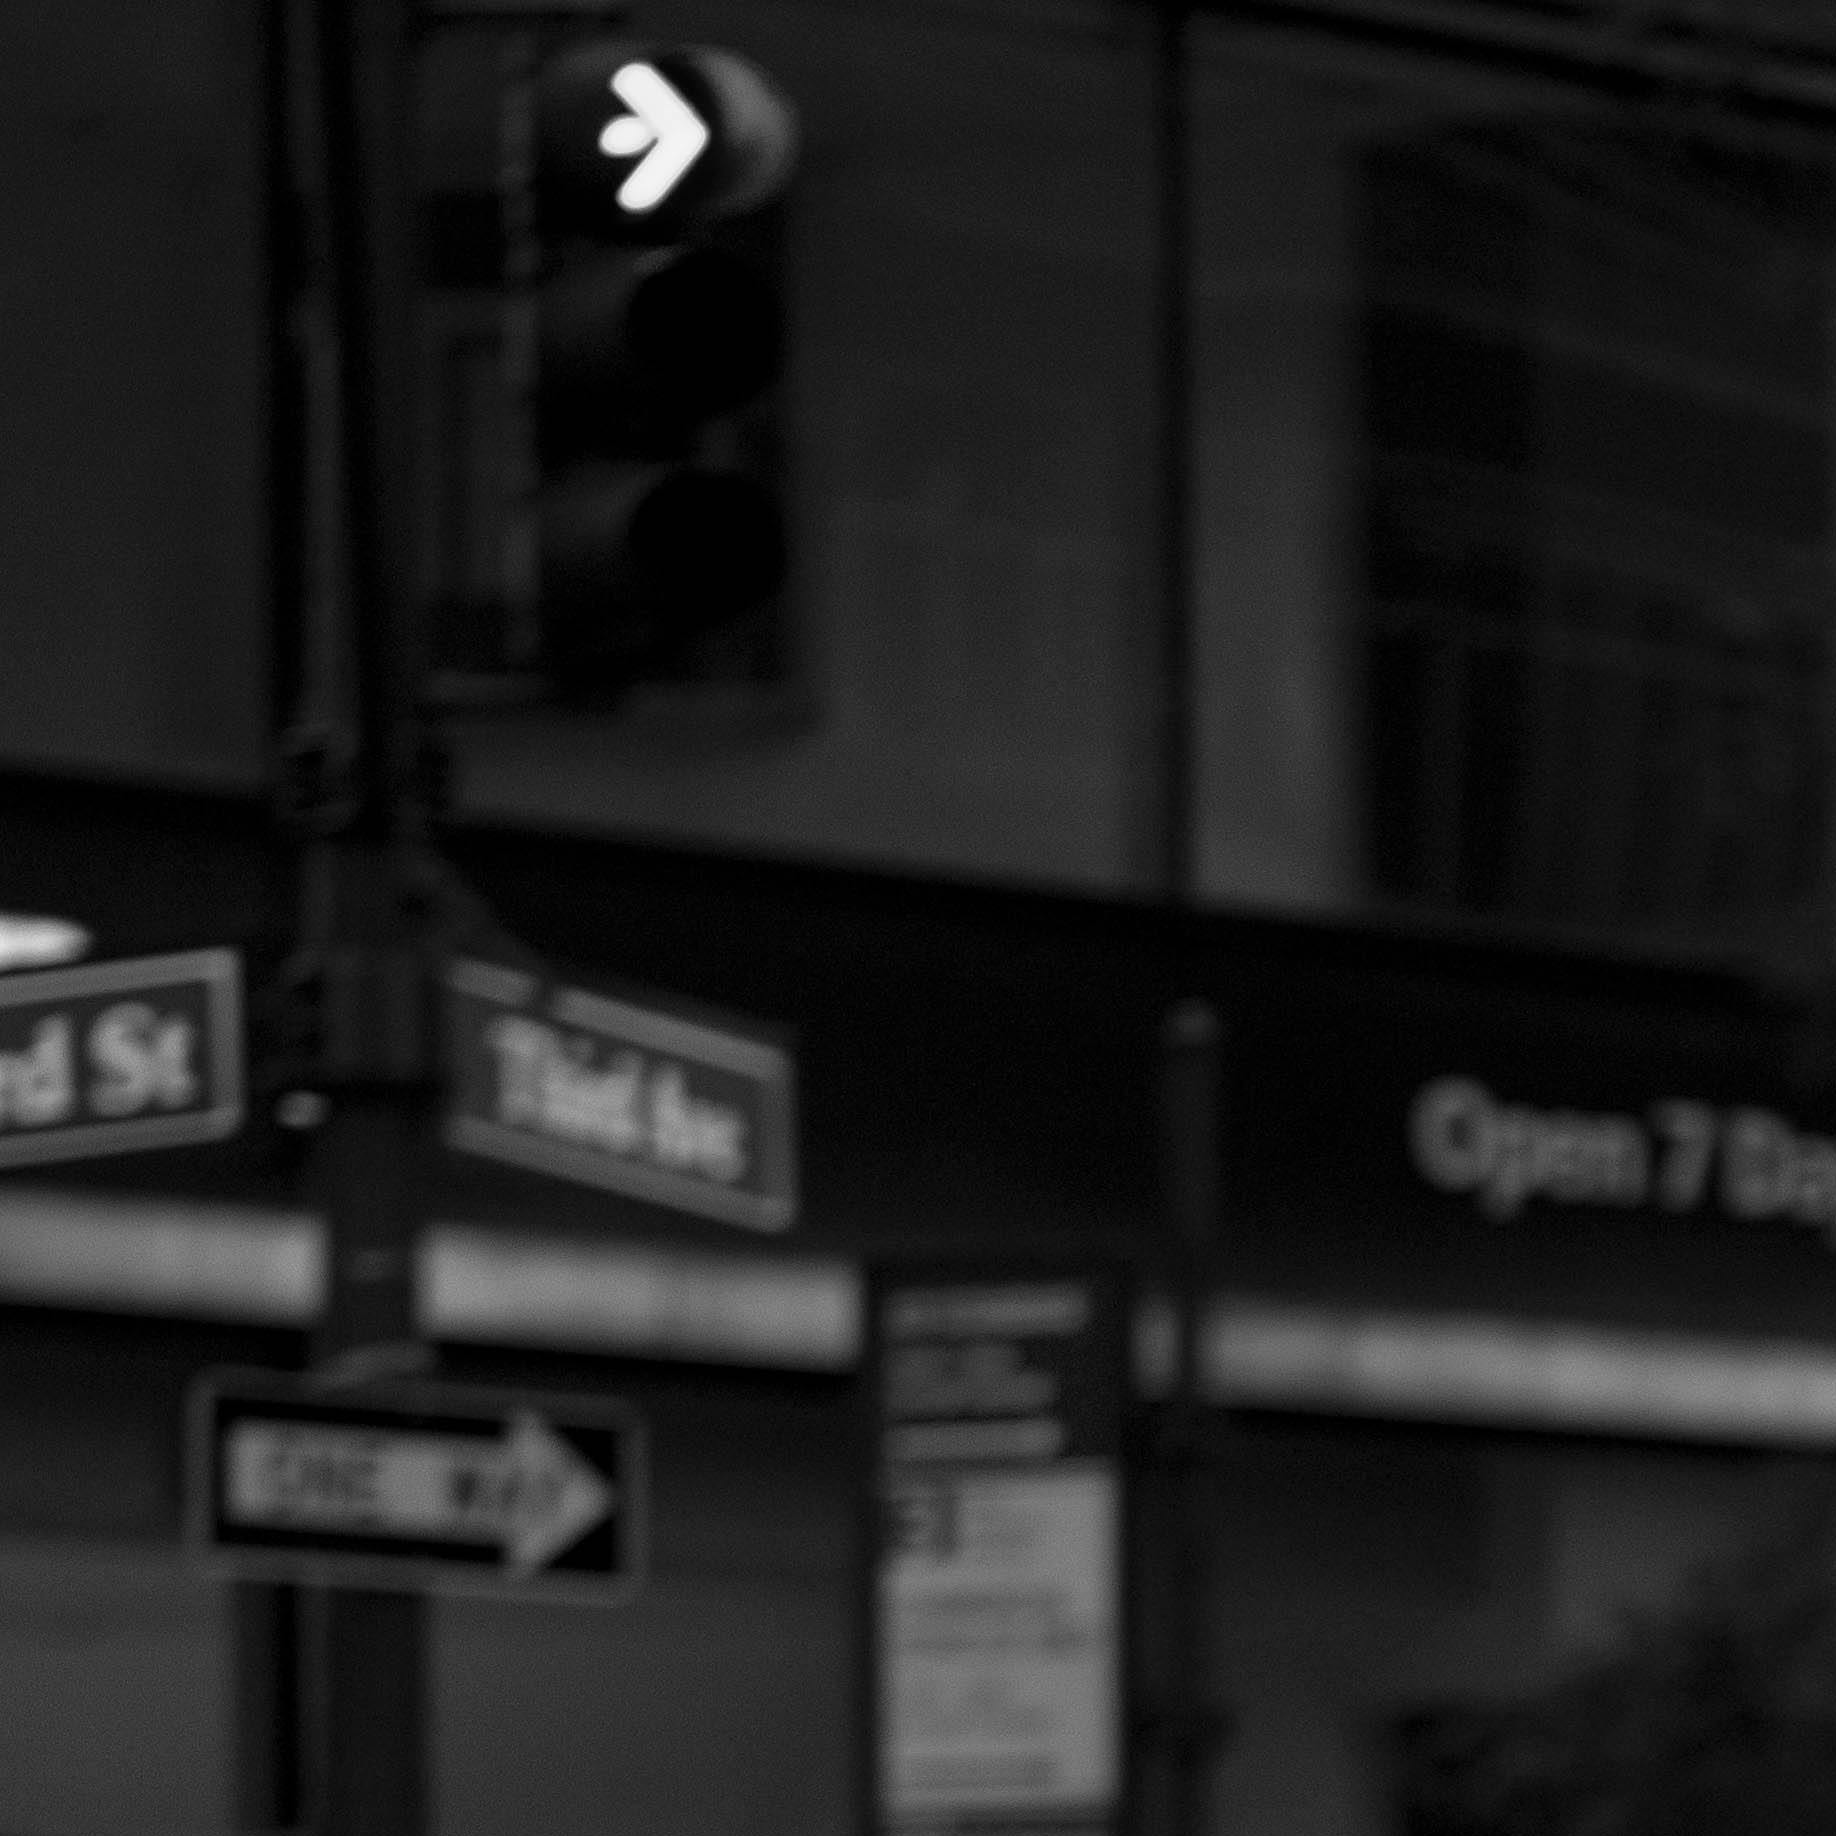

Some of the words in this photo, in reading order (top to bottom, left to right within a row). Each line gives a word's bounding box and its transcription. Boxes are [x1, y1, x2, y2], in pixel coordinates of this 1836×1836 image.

[88, 1000, 196, 1117] St
[1411, 1076, 1646, 1220] Open
[1652, 1099, 1715, 1211] 7
